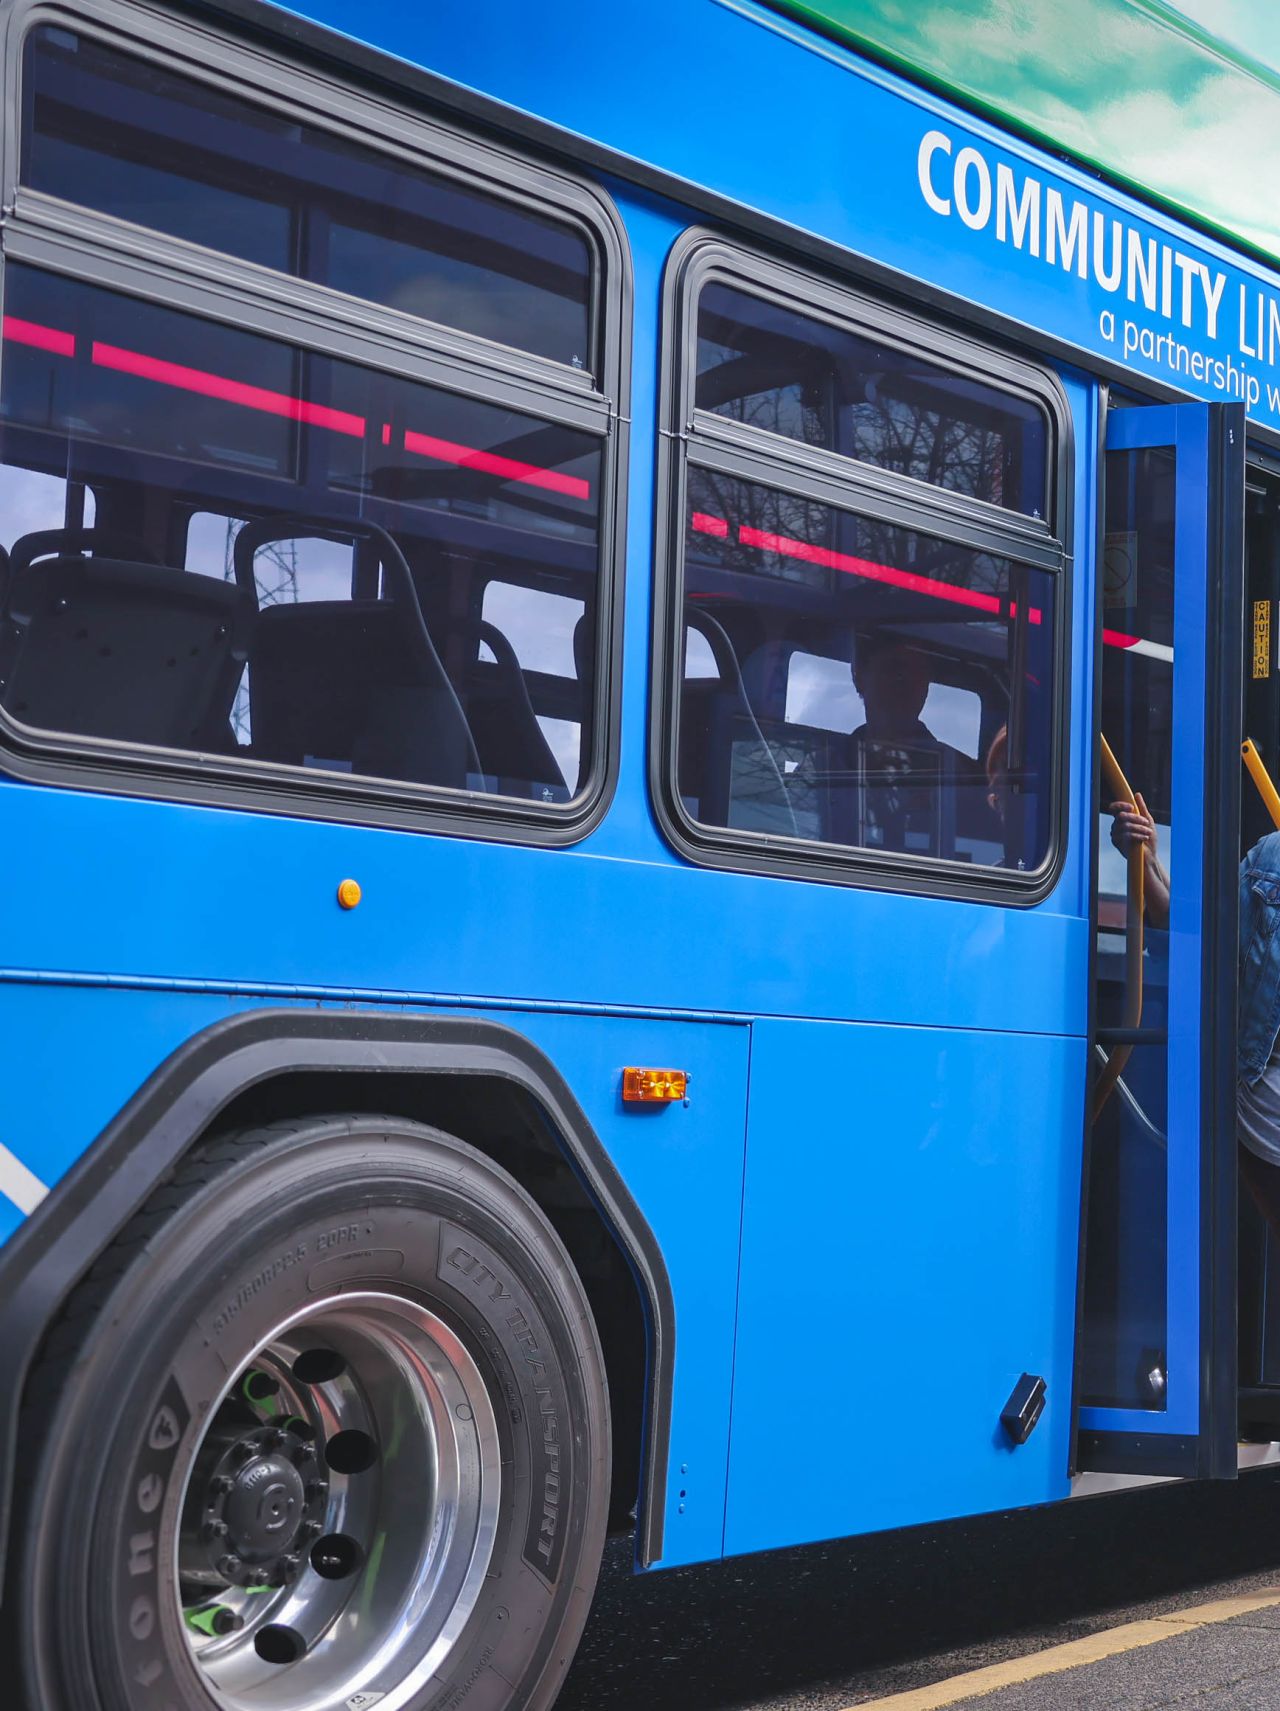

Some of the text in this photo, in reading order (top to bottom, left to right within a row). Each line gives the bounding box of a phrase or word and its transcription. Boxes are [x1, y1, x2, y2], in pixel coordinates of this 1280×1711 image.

[918, 130, 1226, 339] COMMUNITY
[1099, 309, 1115, 341] a
[1124, 320, 1260, 413] partnership
[1257, 602, 1266, 676] CAUTION
[446, 1246, 512, 1304] CITY
[505, 1306, 561, 1567] TRANSPORT
